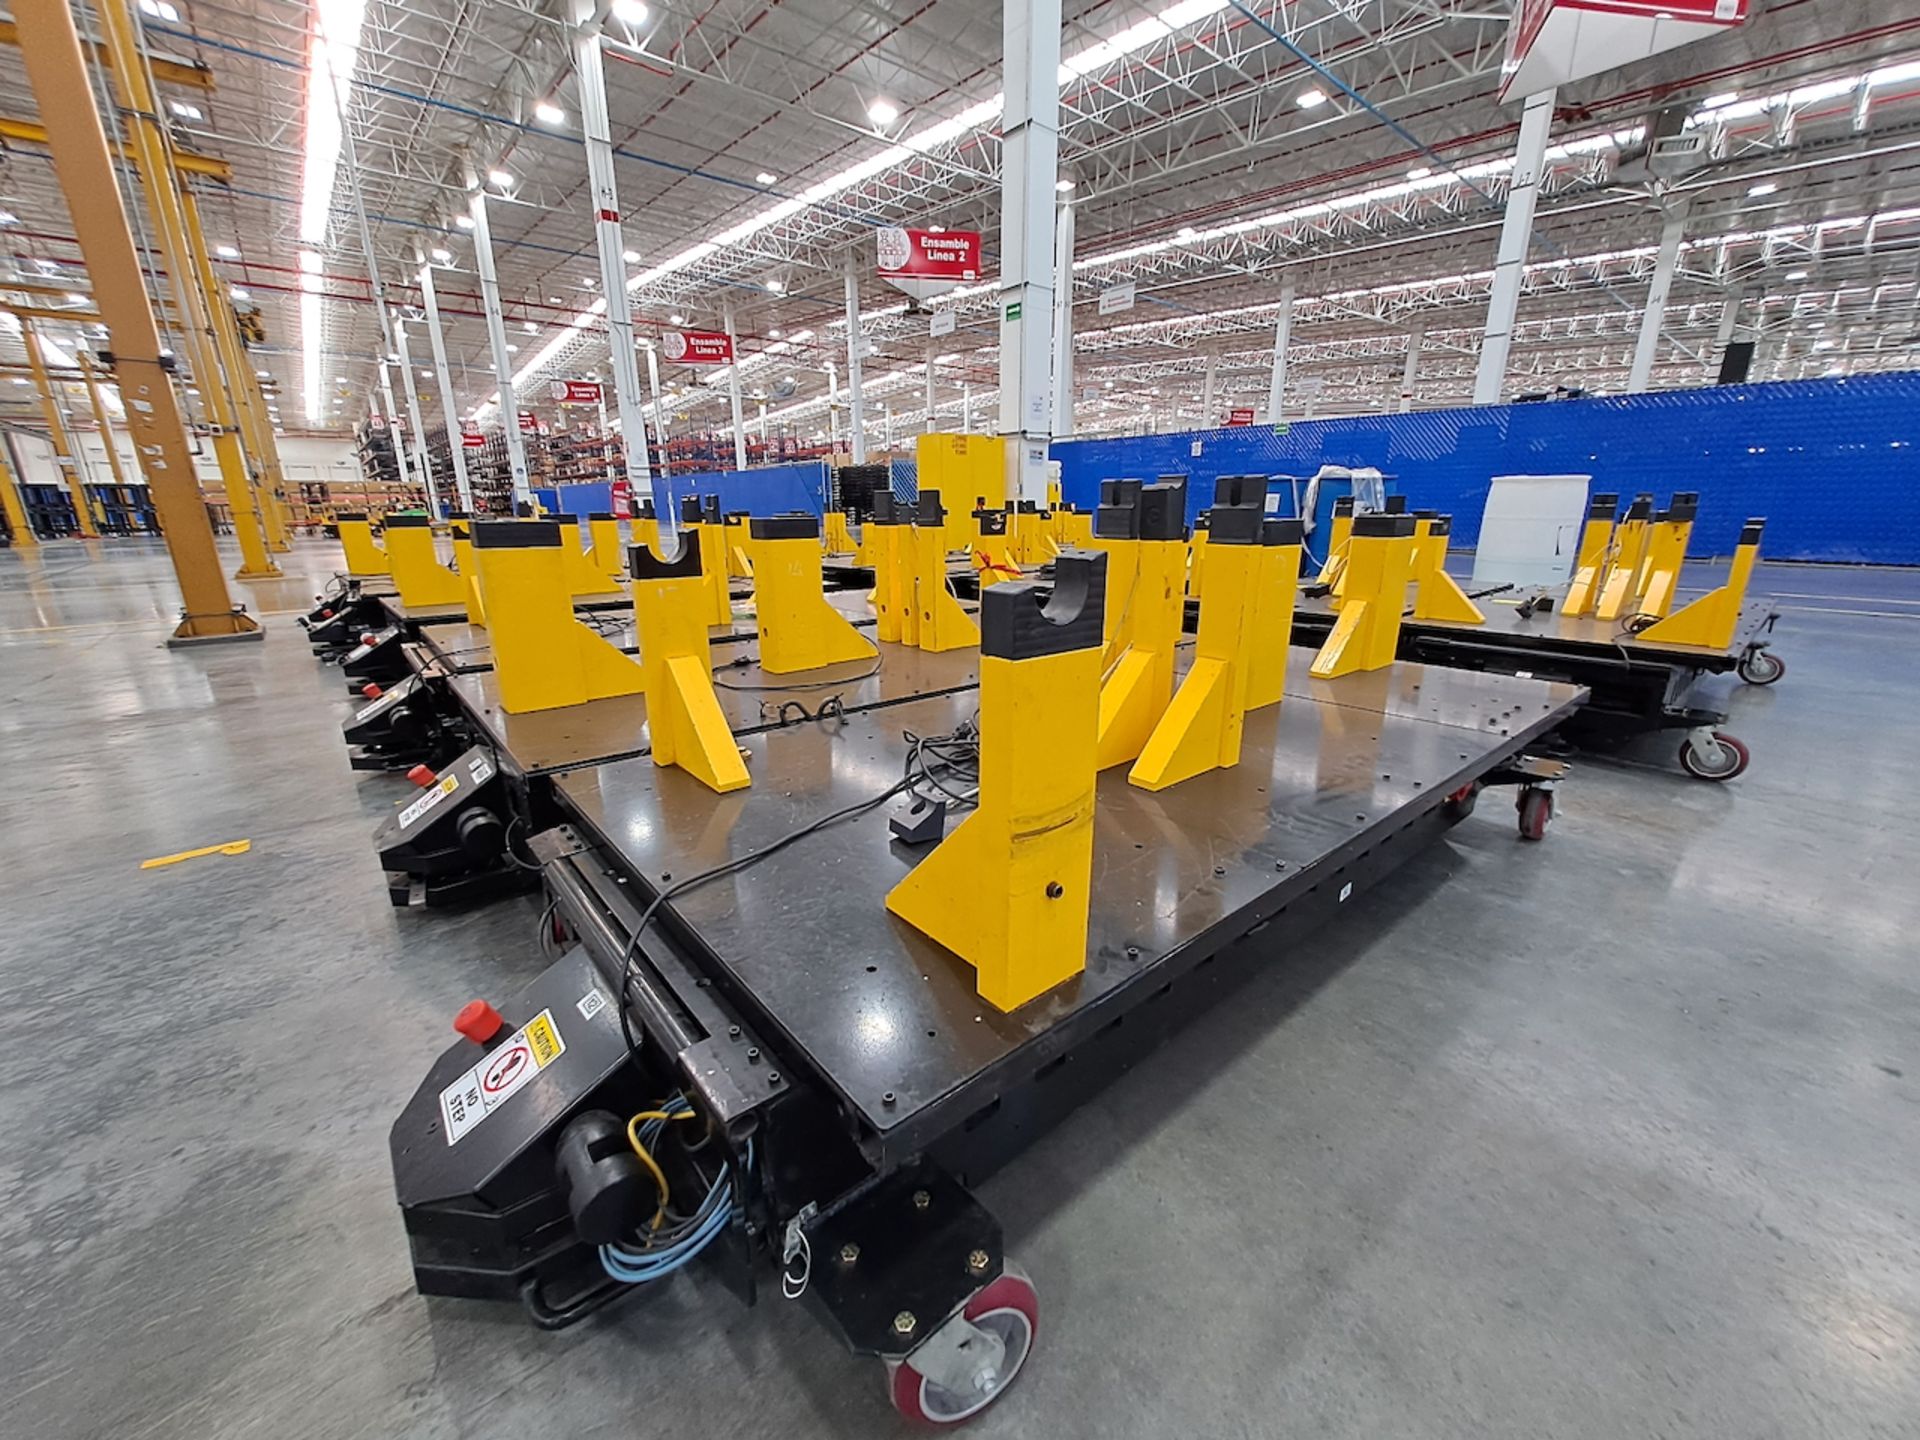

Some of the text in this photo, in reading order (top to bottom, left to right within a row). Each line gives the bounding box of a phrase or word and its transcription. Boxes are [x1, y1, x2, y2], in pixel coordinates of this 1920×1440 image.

[920, 236, 970, 250] Ensamble
[958, 251, 966, 262] 2
[689, 338, 728, 347] Ensamble
[534, 1027, 552, 1060] CAUTION
[465, 1087, 479, 1107] NO
[449, 1094, 466, 1123] STEP
